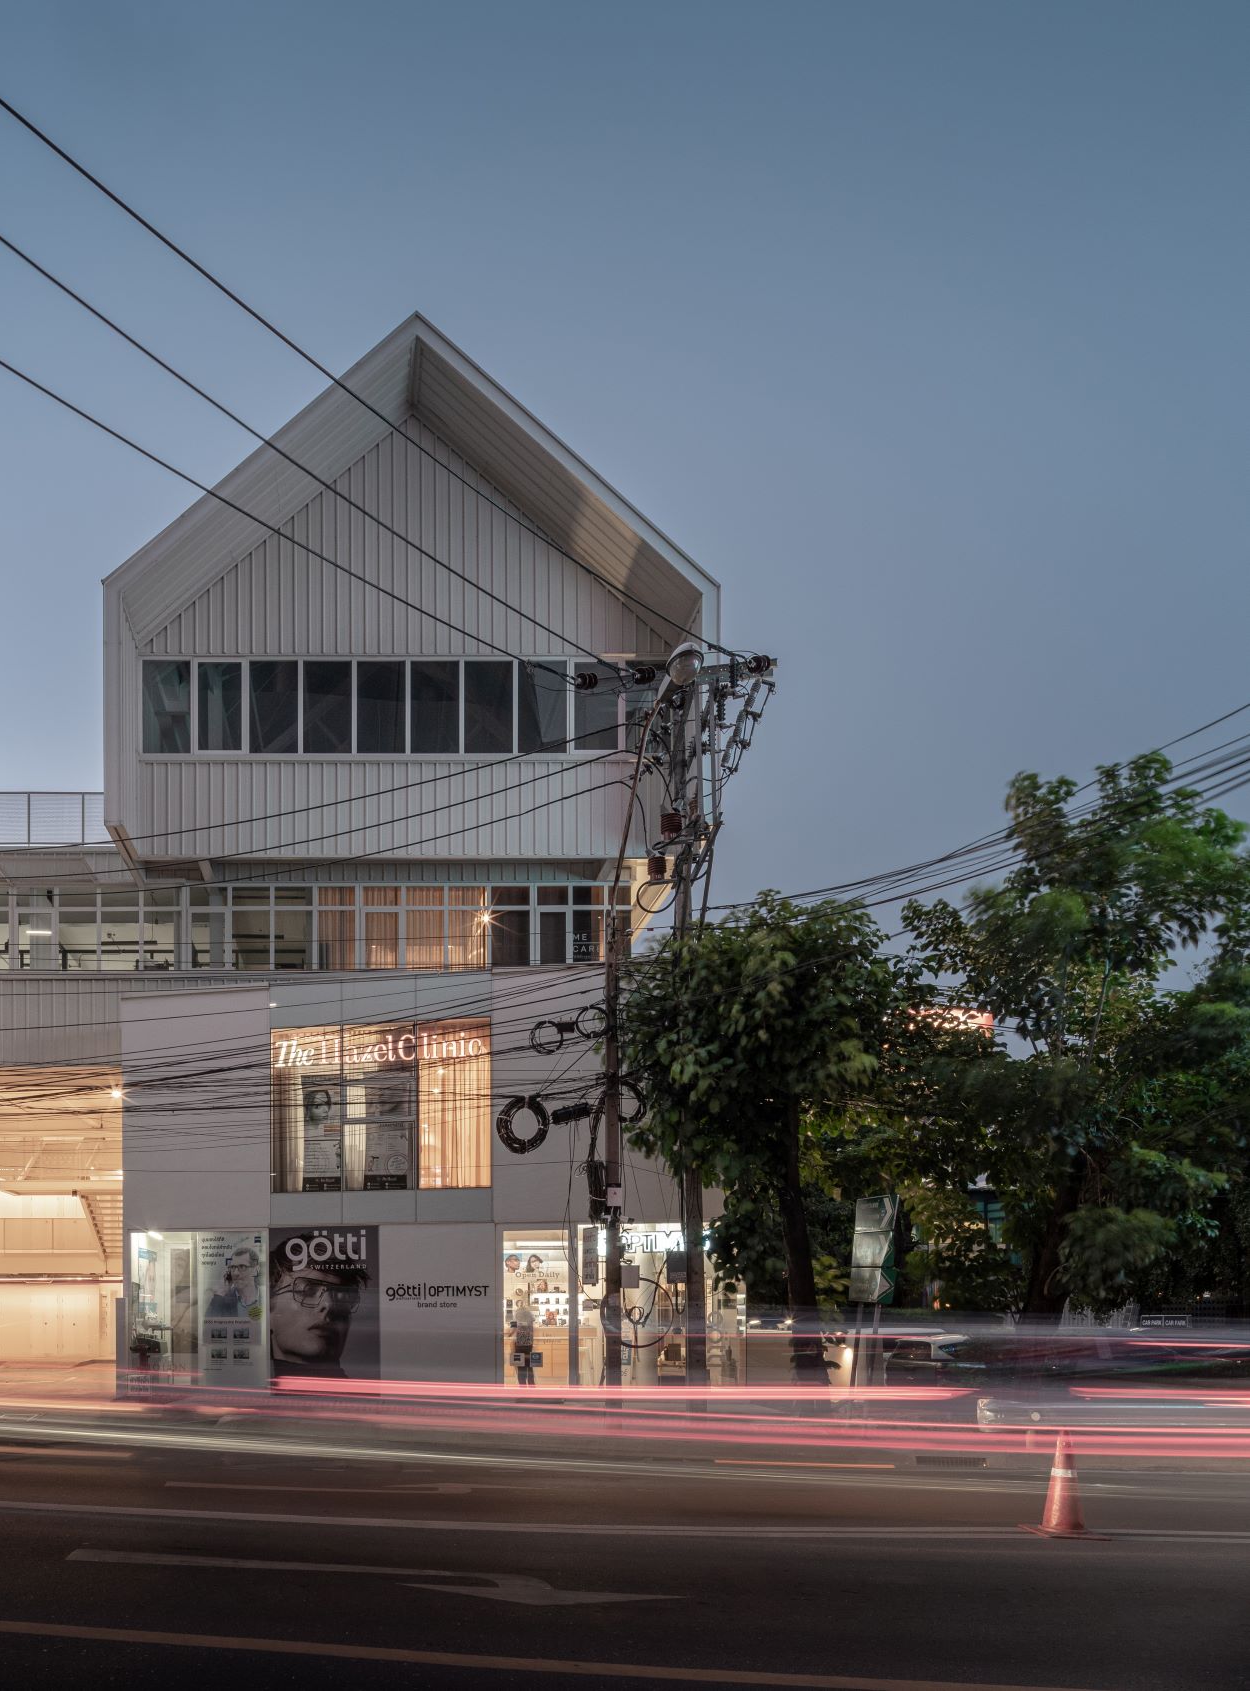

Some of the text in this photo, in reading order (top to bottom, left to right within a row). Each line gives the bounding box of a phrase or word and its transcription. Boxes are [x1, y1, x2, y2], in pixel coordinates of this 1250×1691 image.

[275, 1033, 483, 1068] The Hazel Clinic
[285, 1229, 367, 1271] götti
[515, 1271, 537, 1279] Open
[385, 1283, 489, 1301] götti OPTIMYST
